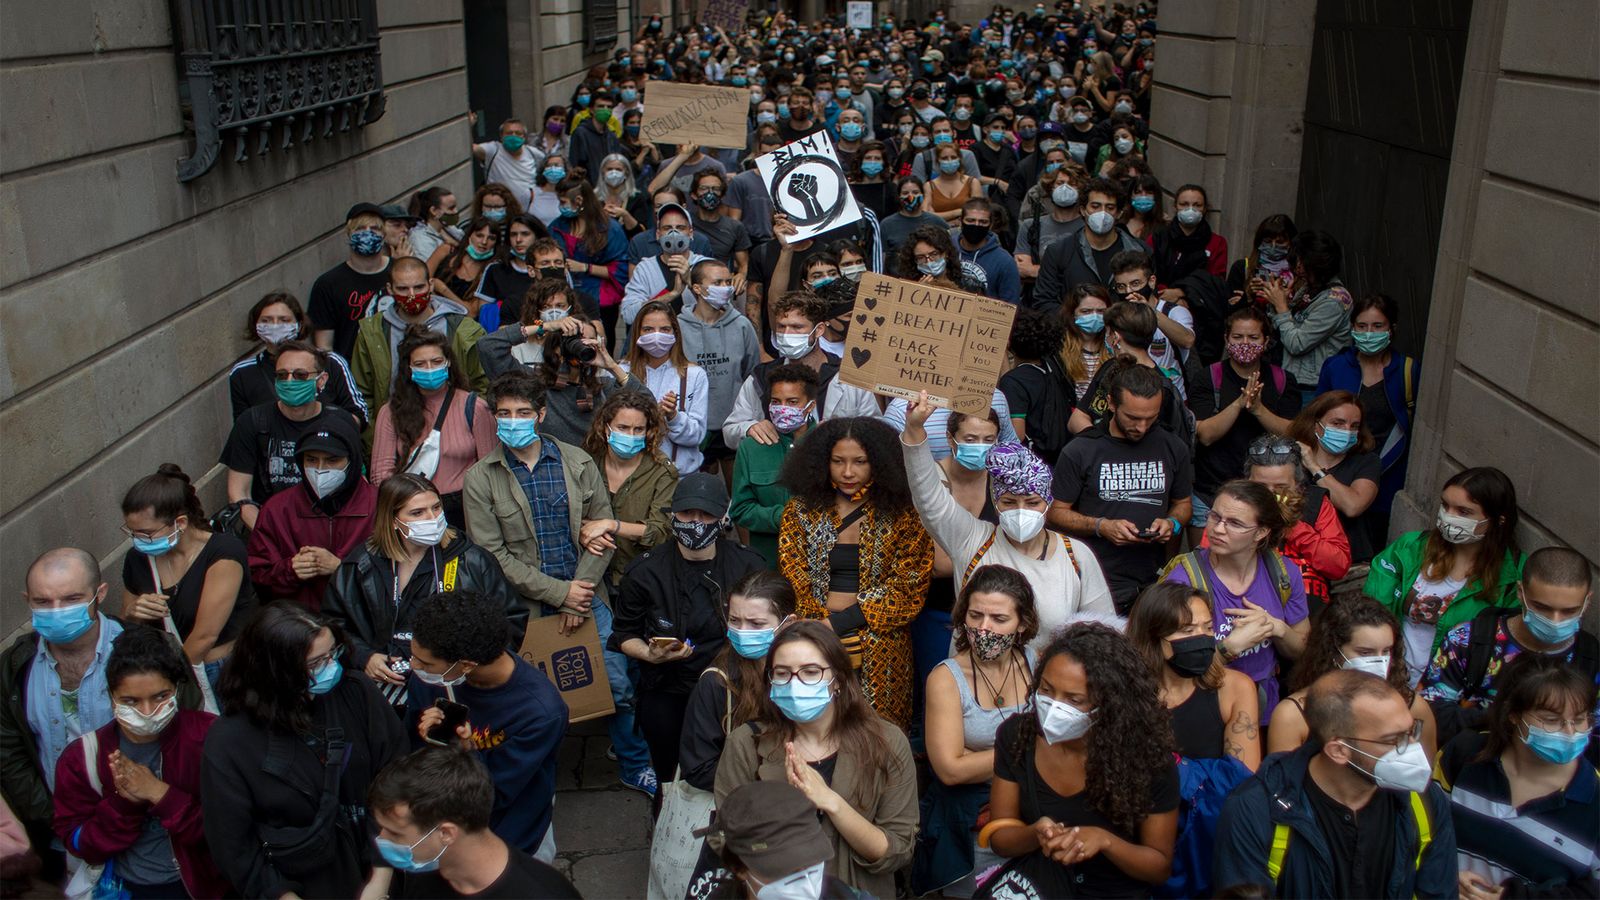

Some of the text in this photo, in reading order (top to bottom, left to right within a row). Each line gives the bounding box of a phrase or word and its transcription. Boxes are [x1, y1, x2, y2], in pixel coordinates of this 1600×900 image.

[703, 116, 725, 135] YA
[898, 286, 904, 303] I
[911, 289, 972, 314] CAN'T
[893, 311, 964, 338] BREATH
[976, 324, 1001, 340] WE
[697, 352, 717, 360] FAKE
[888, 335, 940, 358] BLACK
[970, 341, 1000, 354] LOVE
[697, 357, 730, 366] SYSTEM
[973, 356, 991, 366] YOU
[900, 367, 954, 388] MATTER
[1100, 461, 1165, 480] ANIMAL
[1100, 478, 1165, 491] LIBERATION
[556, 653, 576, 689] Vella
[570, 650, 588, 684] Font
